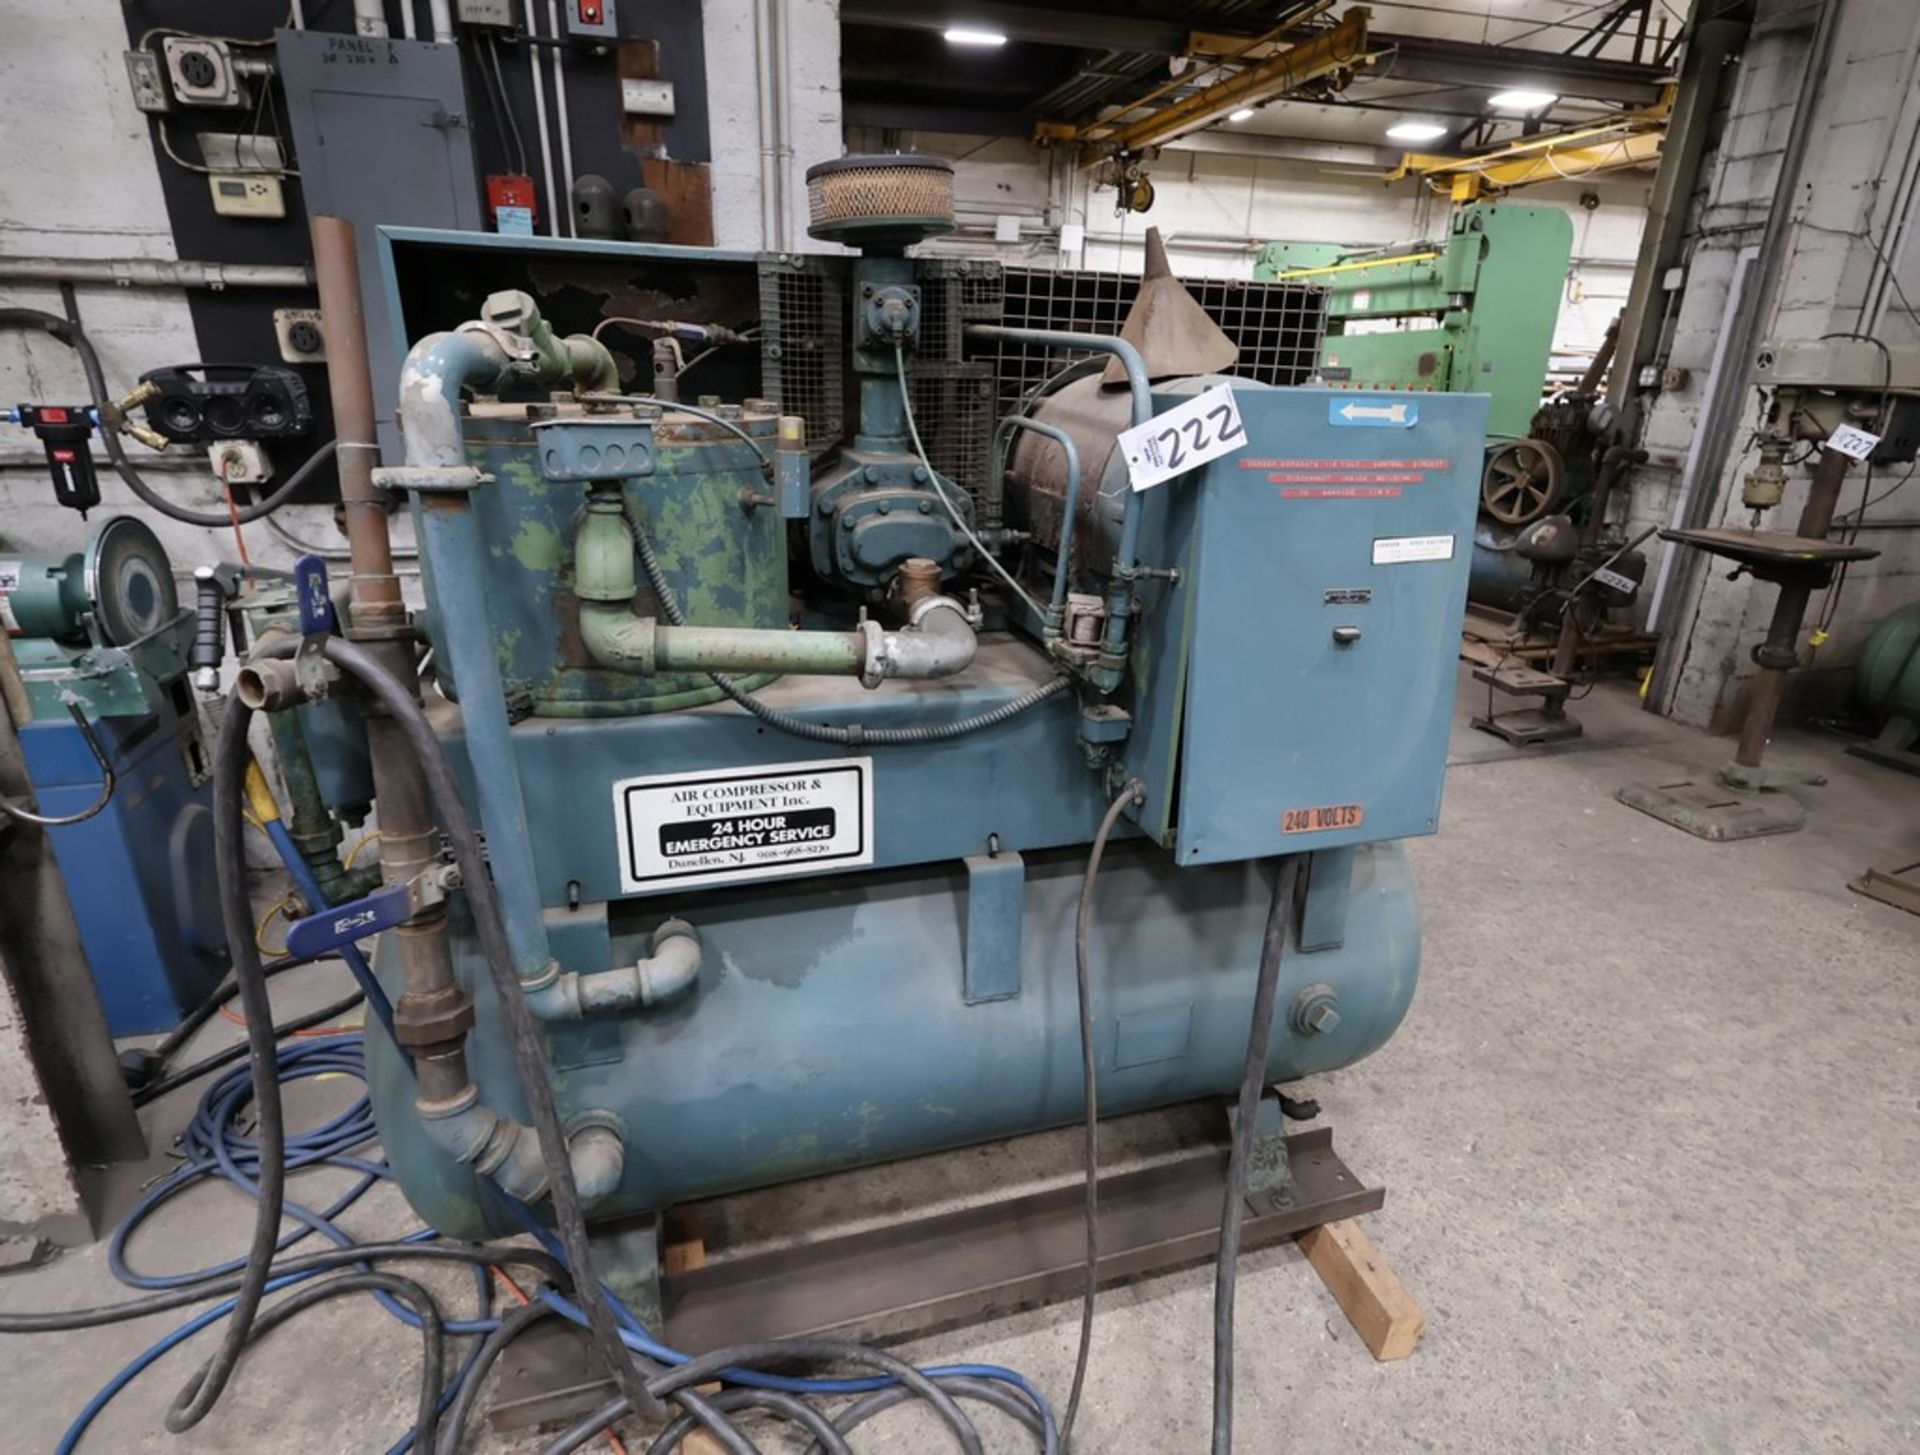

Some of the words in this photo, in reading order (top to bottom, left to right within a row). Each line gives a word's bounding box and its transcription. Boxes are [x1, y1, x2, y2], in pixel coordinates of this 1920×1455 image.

[1158, 404, 1242, 469] 222
[1843, 433, 1874, 455] 227
[672, 791, 699, 803] AIR
[702, 780, 807, 800] COMPRESSOR
[811, 779, 823, 790] &
[686, 797, 778, 817] EQUIPMENT
[783, 796, 810, 806] Inc.
[1285, 810, 1309, 831] 240
[1317, 805, 1356, 827] VOLTS
[712, 821, 734, 835] 24
[738, 816, 787, 832] HOUR
[665, 832, 766, 855] EMERGENCY
[769, 825, 831, 843] SERVICE
